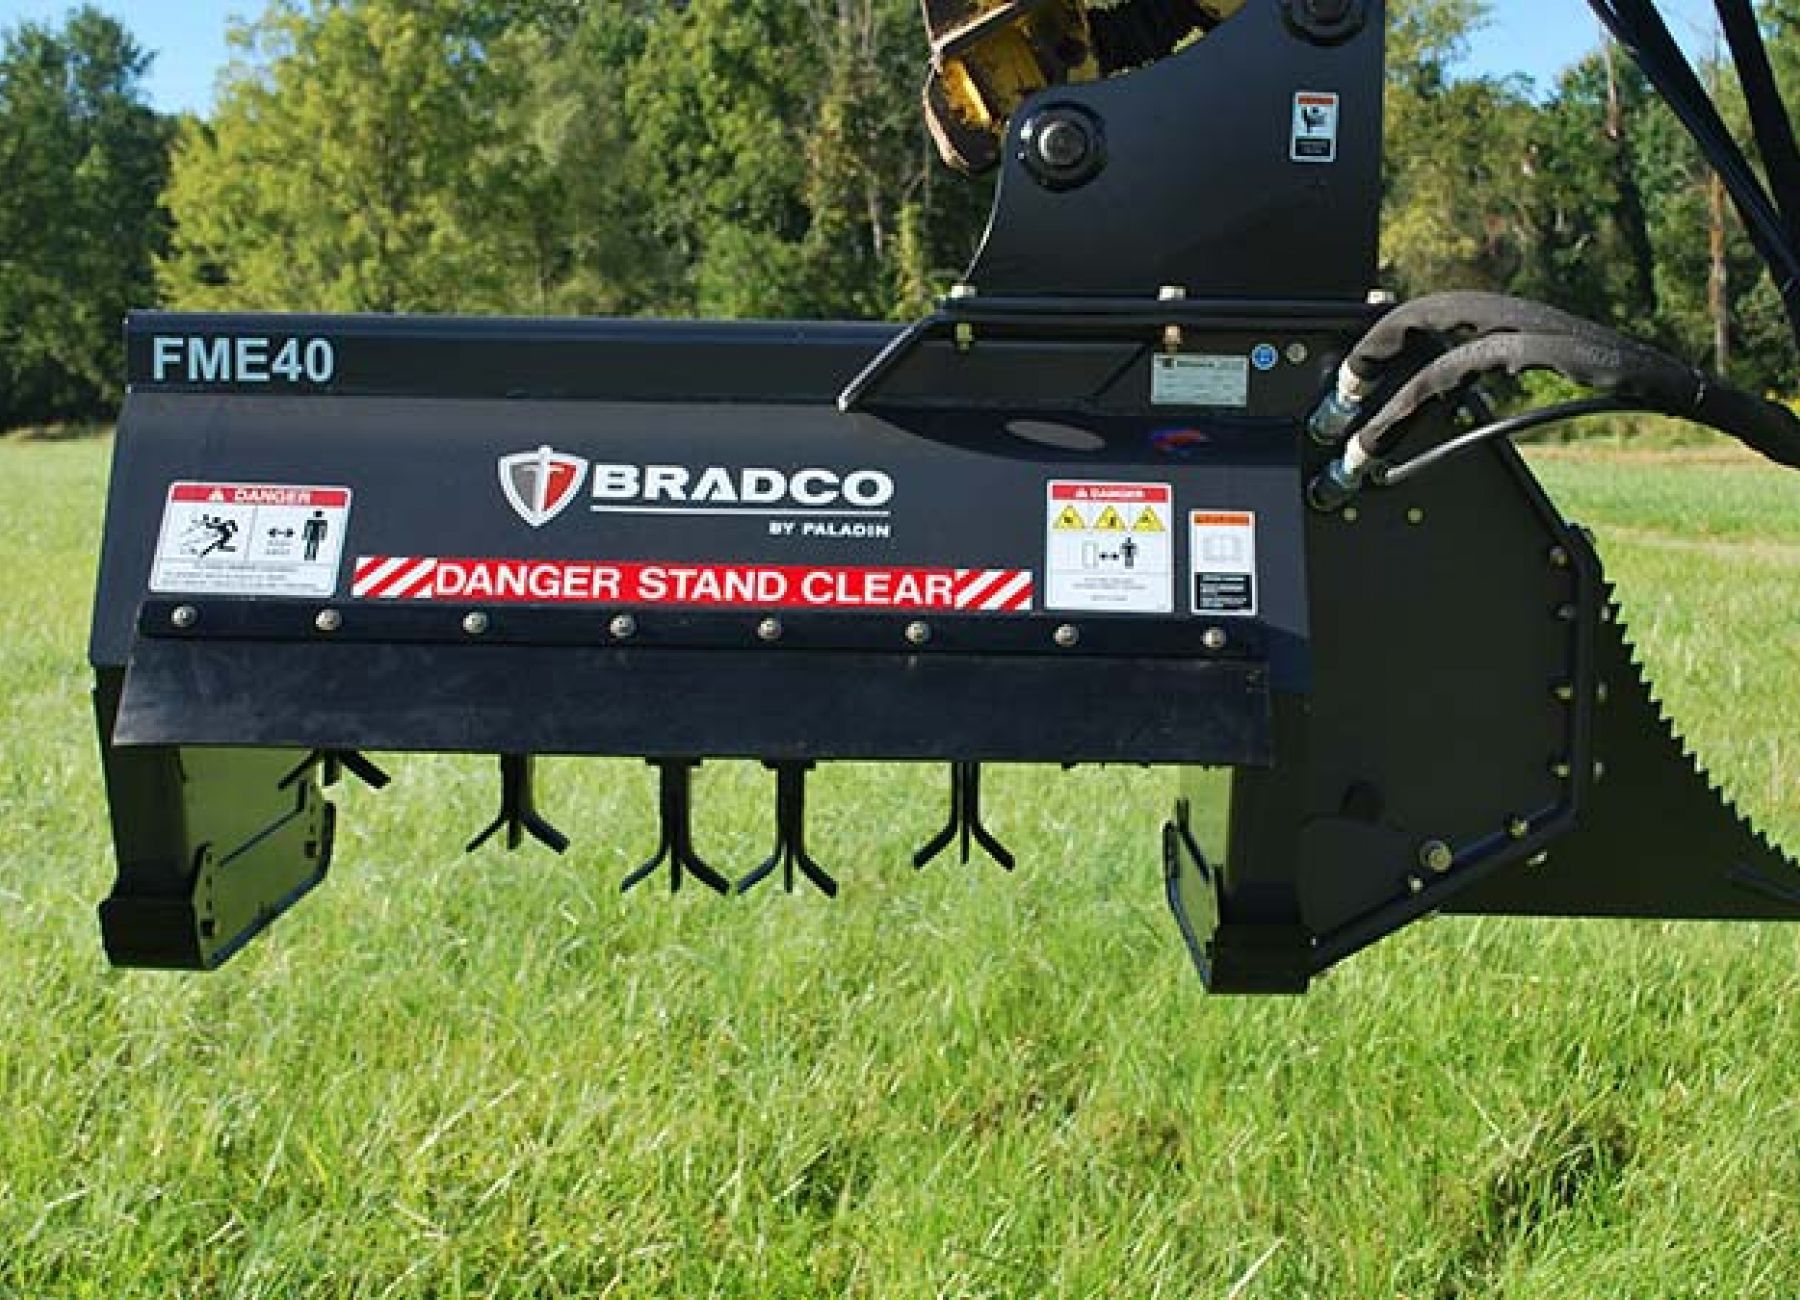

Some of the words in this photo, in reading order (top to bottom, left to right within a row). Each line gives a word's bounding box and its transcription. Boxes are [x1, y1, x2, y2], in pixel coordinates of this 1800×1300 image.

[153, 337, 334, 382] FME40
[592, 465, 894, 506] BRADCO
[769, 522, 794, 534] BY
[803, 523, 890, 538] PALADIN
[436, 564, 621, 600] DANGER
[637, 567, 787, 602] STAND
[802, 571, 953, 605] CLEAR
